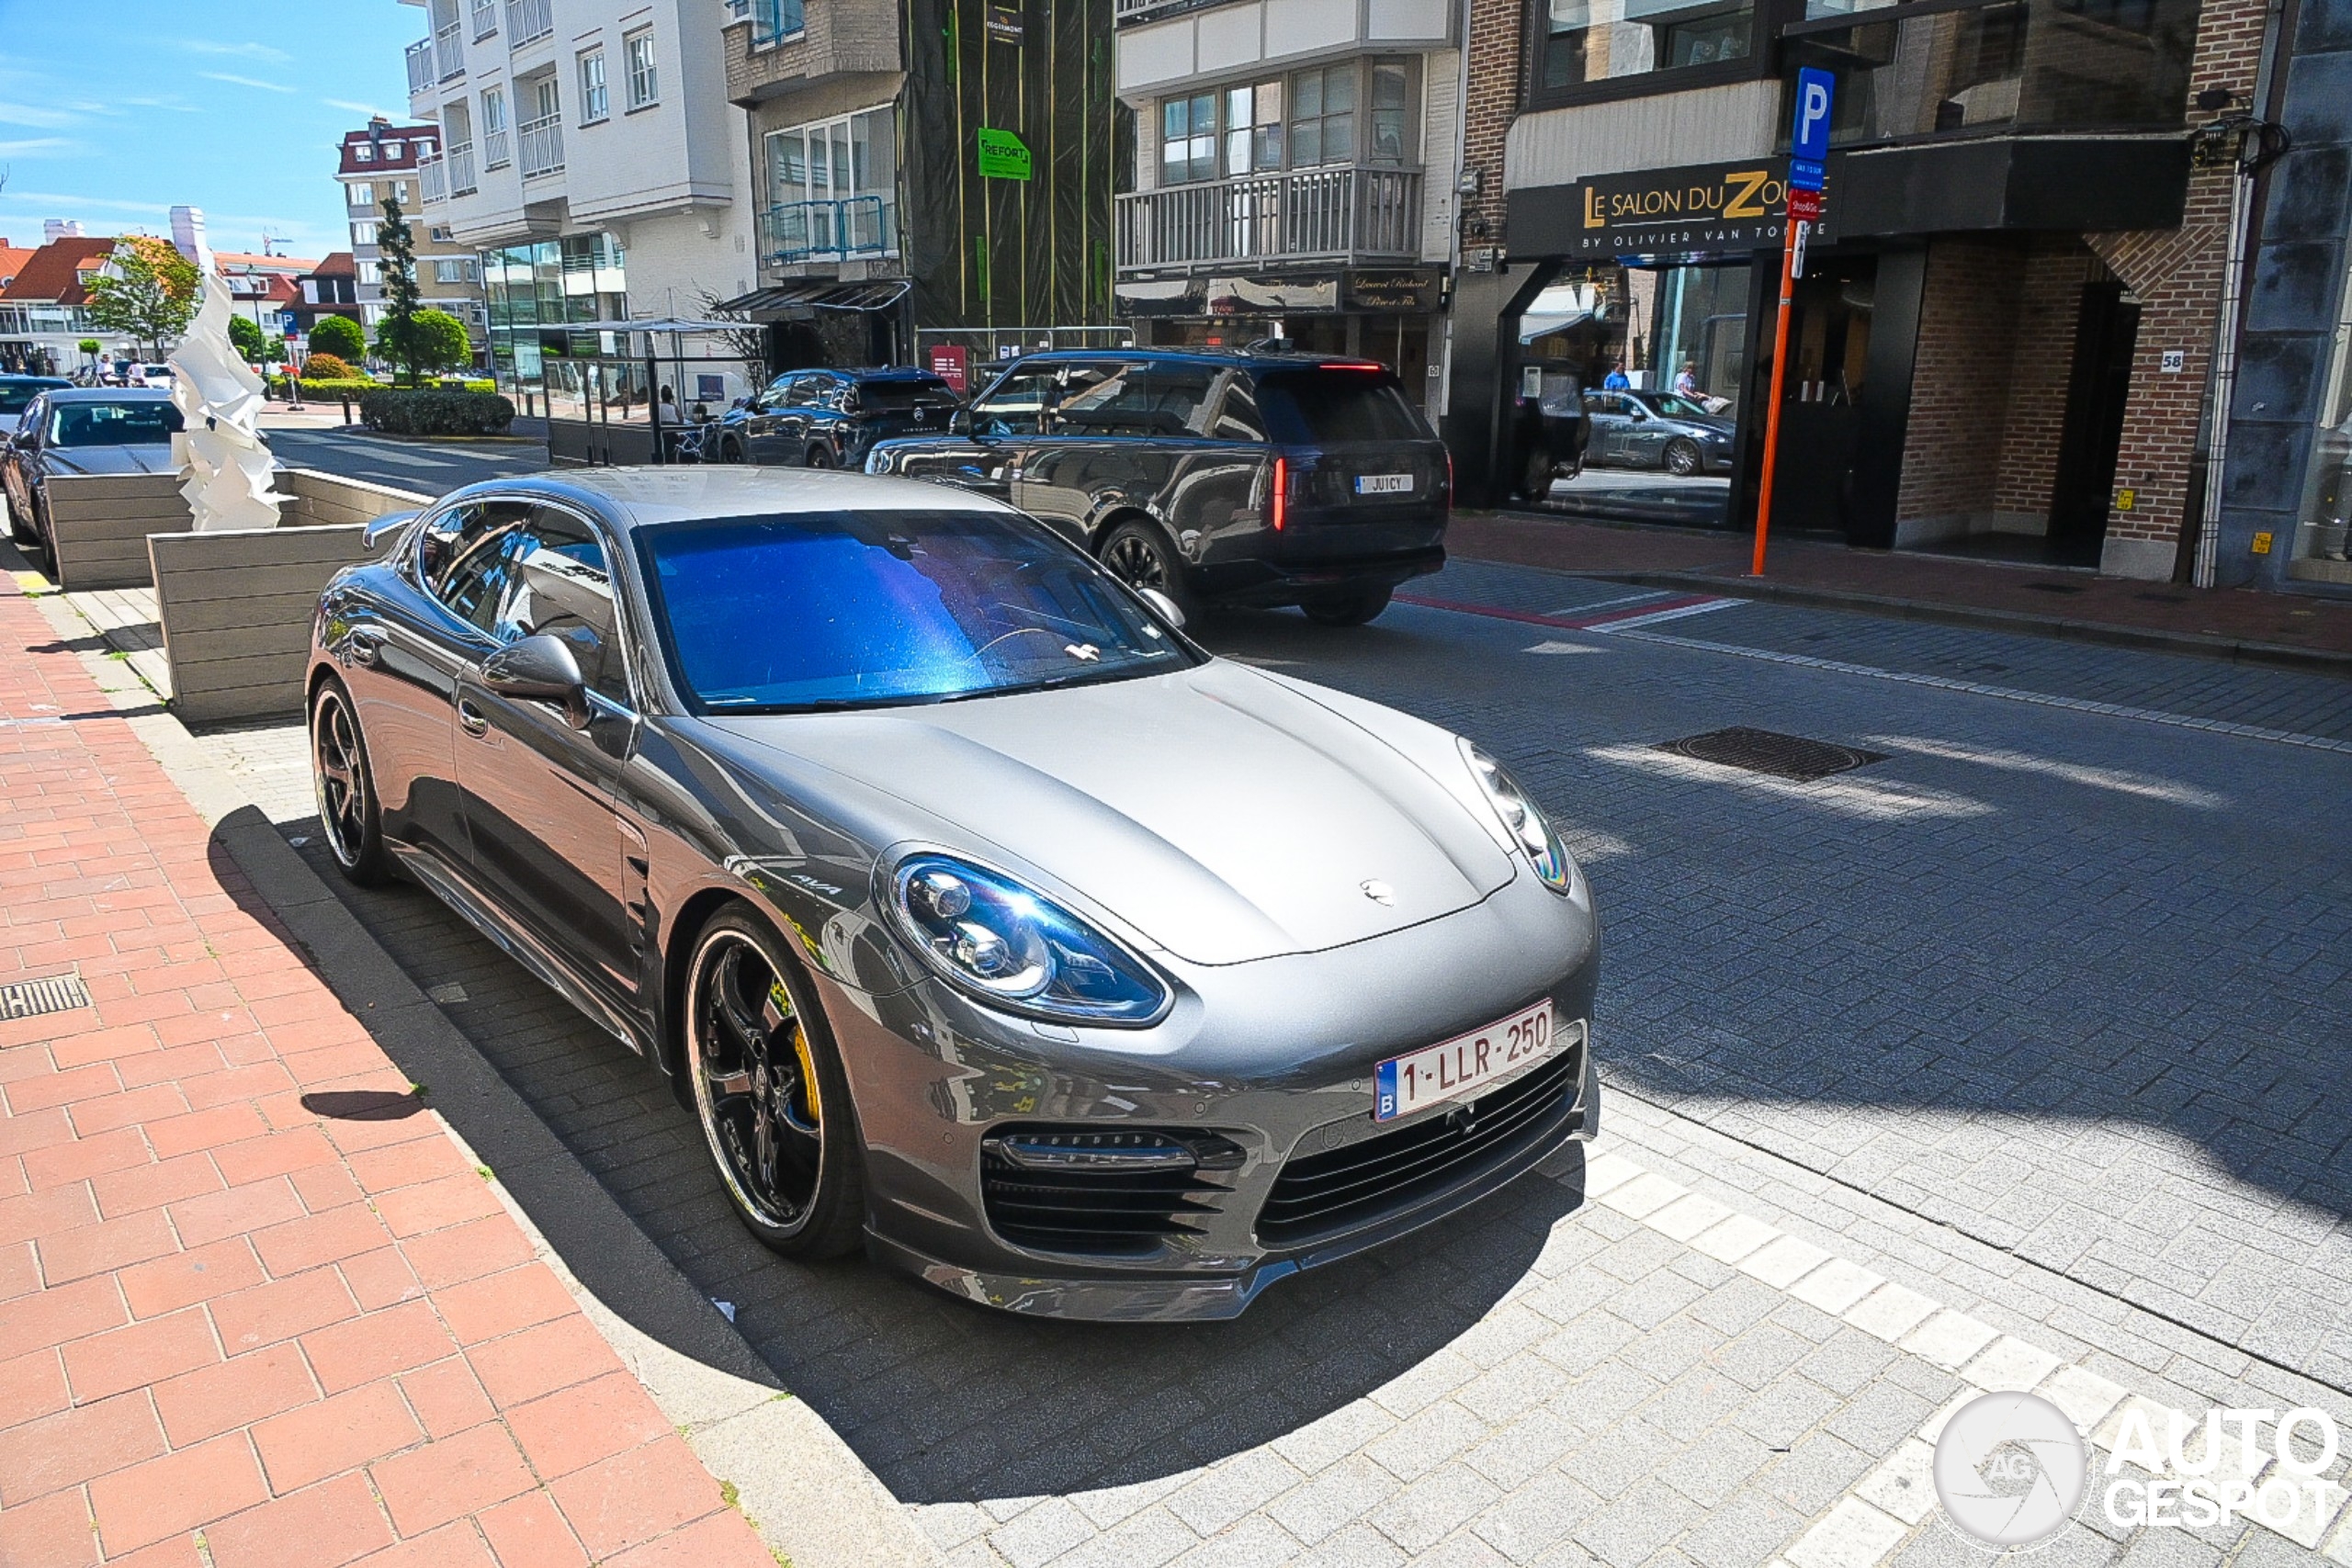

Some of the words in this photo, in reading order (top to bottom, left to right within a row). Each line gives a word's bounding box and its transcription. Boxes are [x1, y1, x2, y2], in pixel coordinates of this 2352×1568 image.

[1801, 83, 1827, 144] P
[985, 145, 1025, 158] REFORT
[1611, 189, 1681, 217] SALON
[1689, 186, 1724, 210] DU
[1582, 238, 1601, 248] BY
[1613, 231, 1690, 246] OLIVIER
[1704, 229, 1740, 241] VAN
[283, 314, 294, 327] P
[2163, 355, 2182, 367] 58
[1403, 1010, 1548, 1102] 1-LLR-250
[1381, 1094, 1394, 1113] B
